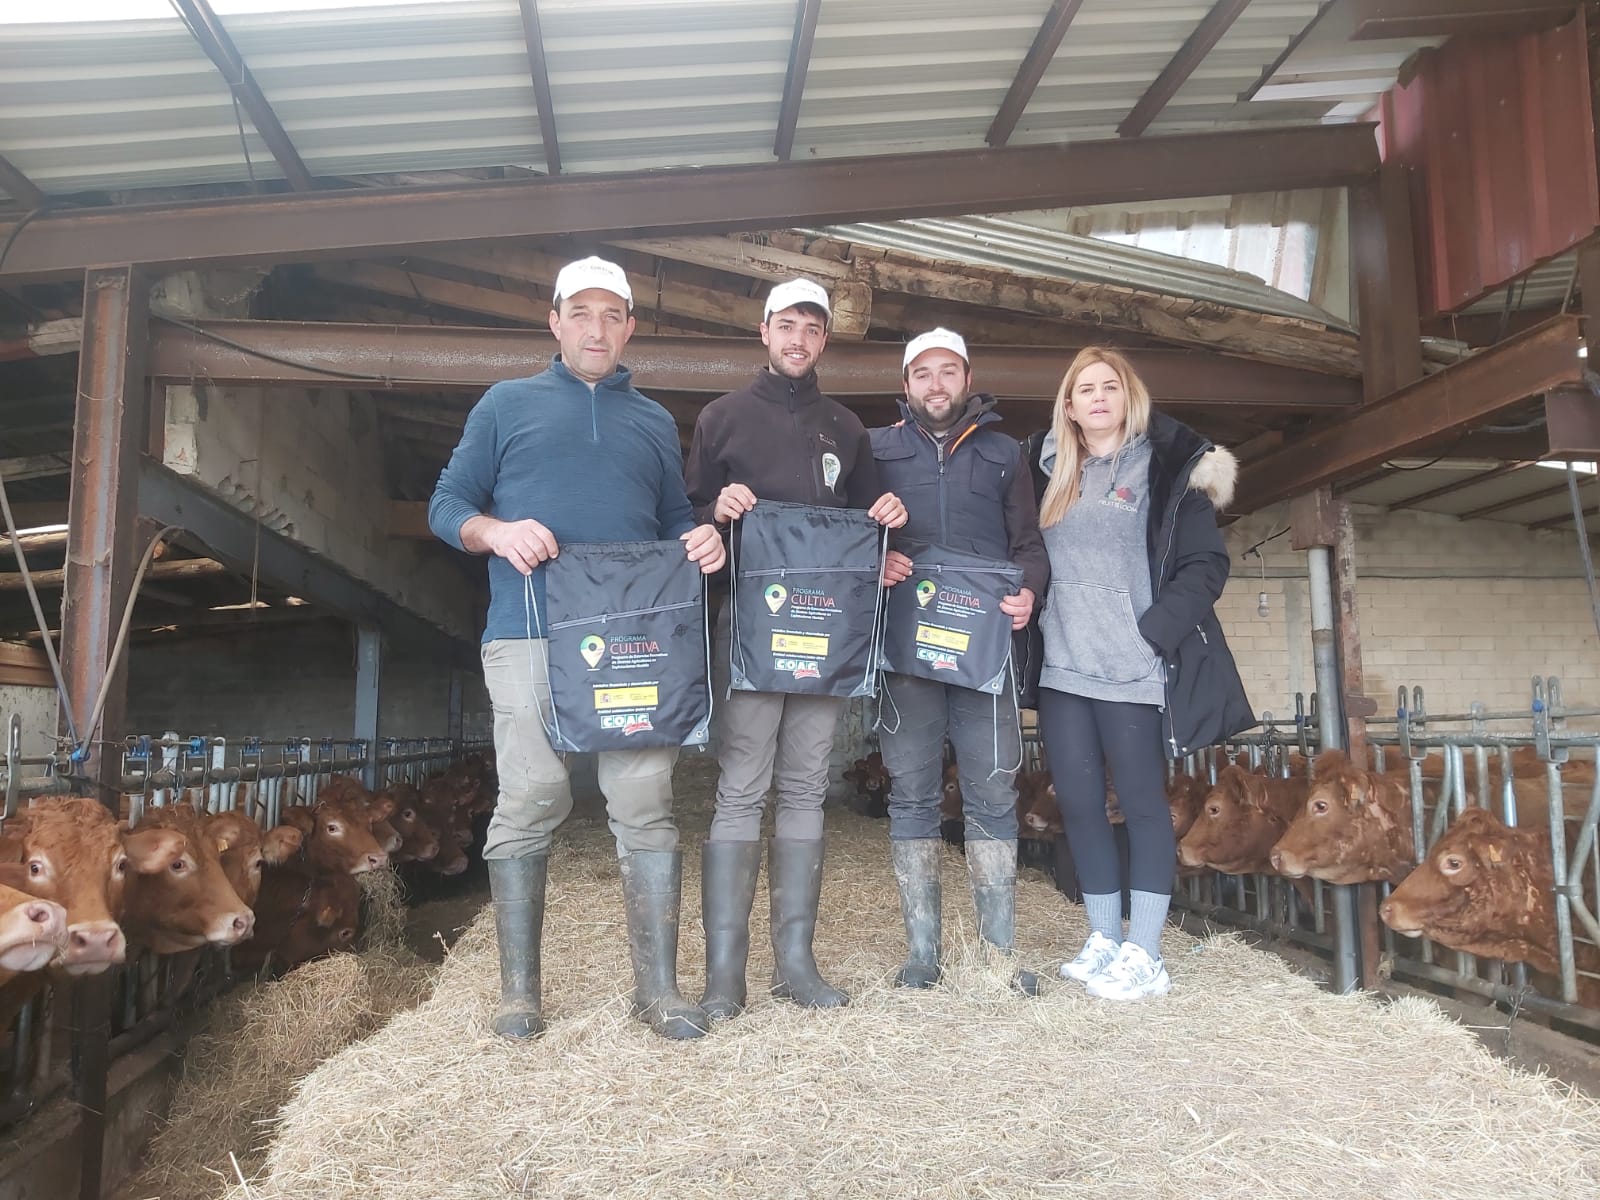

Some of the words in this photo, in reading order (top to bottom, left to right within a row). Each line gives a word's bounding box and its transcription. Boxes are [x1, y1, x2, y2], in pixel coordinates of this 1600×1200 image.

[792, 587, 825, 596] PROGRAMA
[790, 594, 836, 608] CULTIVA
[938, 591, 981, 608] CULTIVA
[610, 635, 647, 643] PROGRAMA
[610, 641, 660, 655] CULTIVA
[919, 649, 956, 663] COAG
[776, 659, 818, 670] COAG
[602, 714, 649, 728] COAG
